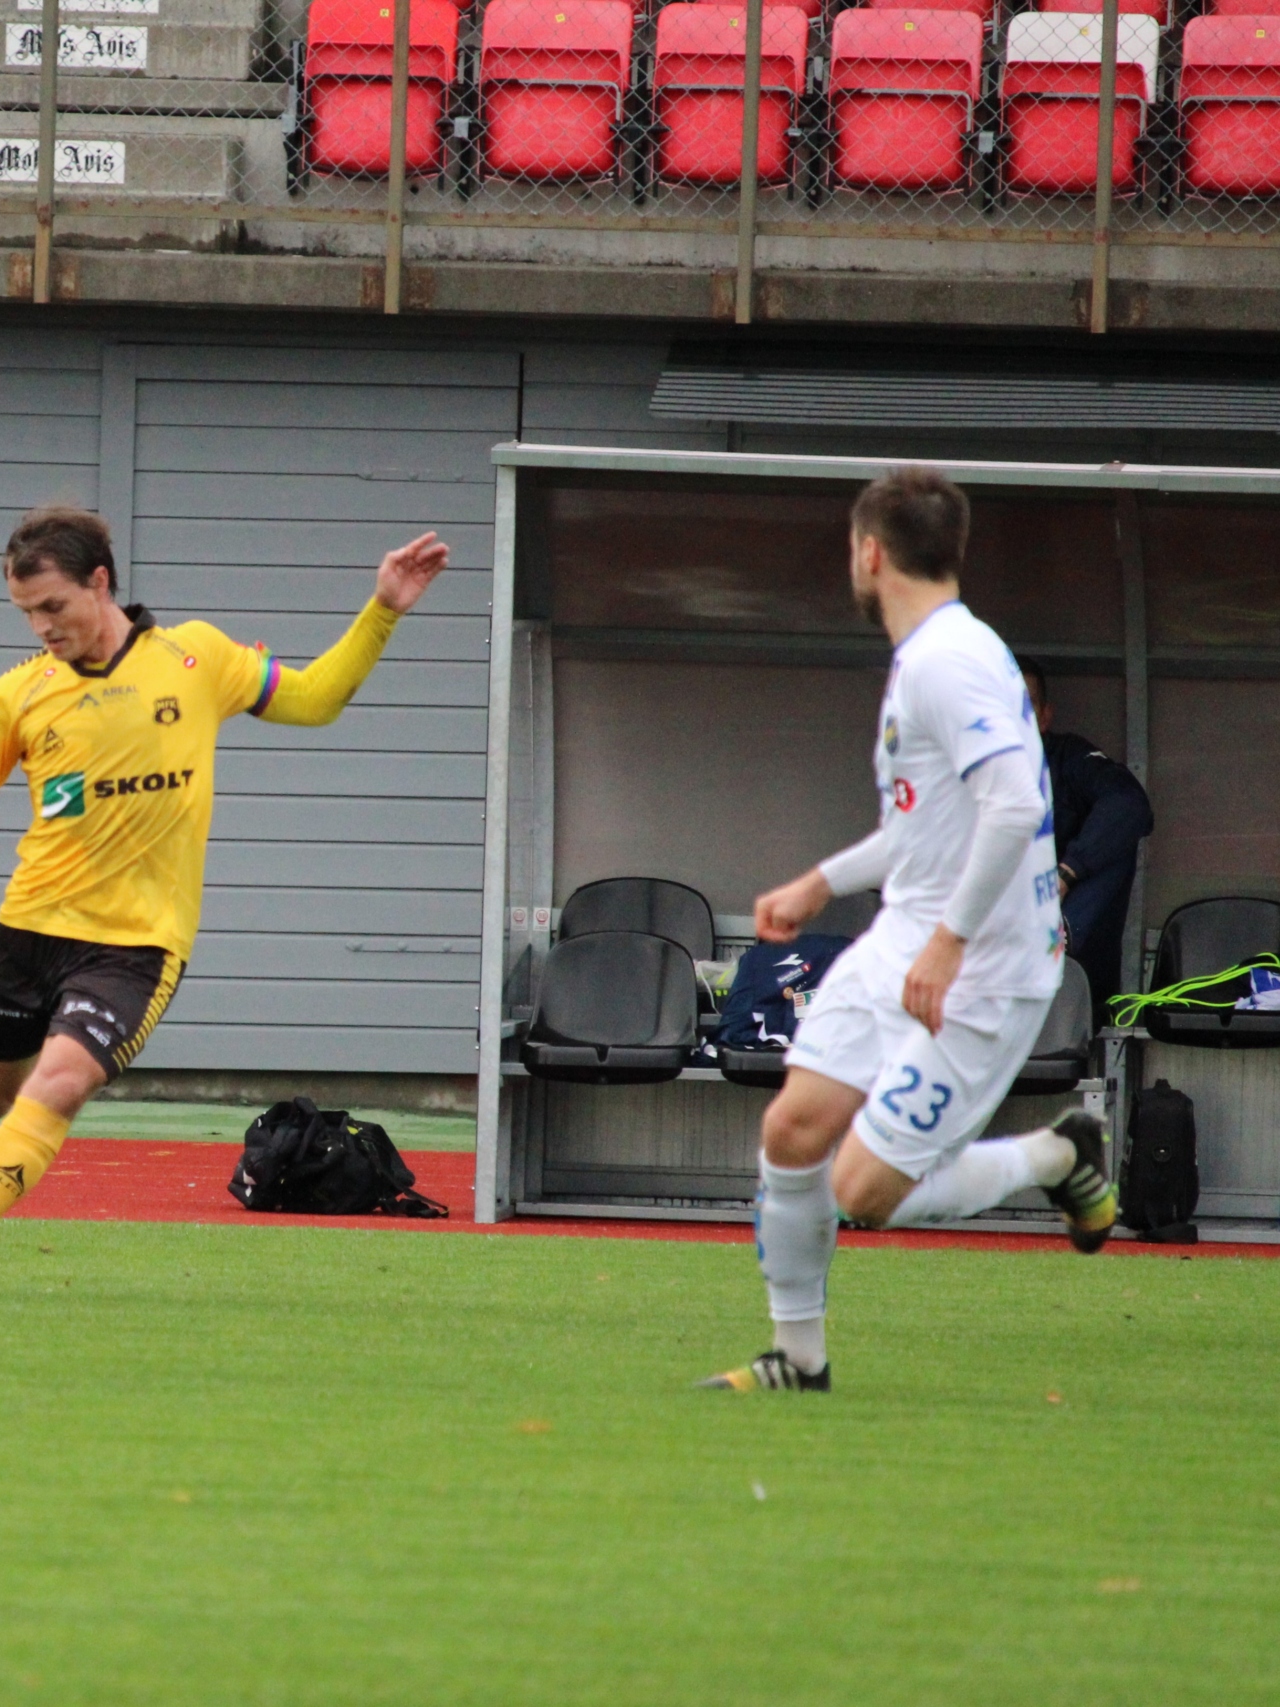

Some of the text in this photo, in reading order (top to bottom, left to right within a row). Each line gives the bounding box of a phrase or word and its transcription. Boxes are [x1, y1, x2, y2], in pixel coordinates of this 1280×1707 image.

[83, 30, 138, 61] Avis
[61, 145, 115, 177] Avis
[94, 769, 194, 799] SKOLT
[880, 1064, 952, 1132] 23
